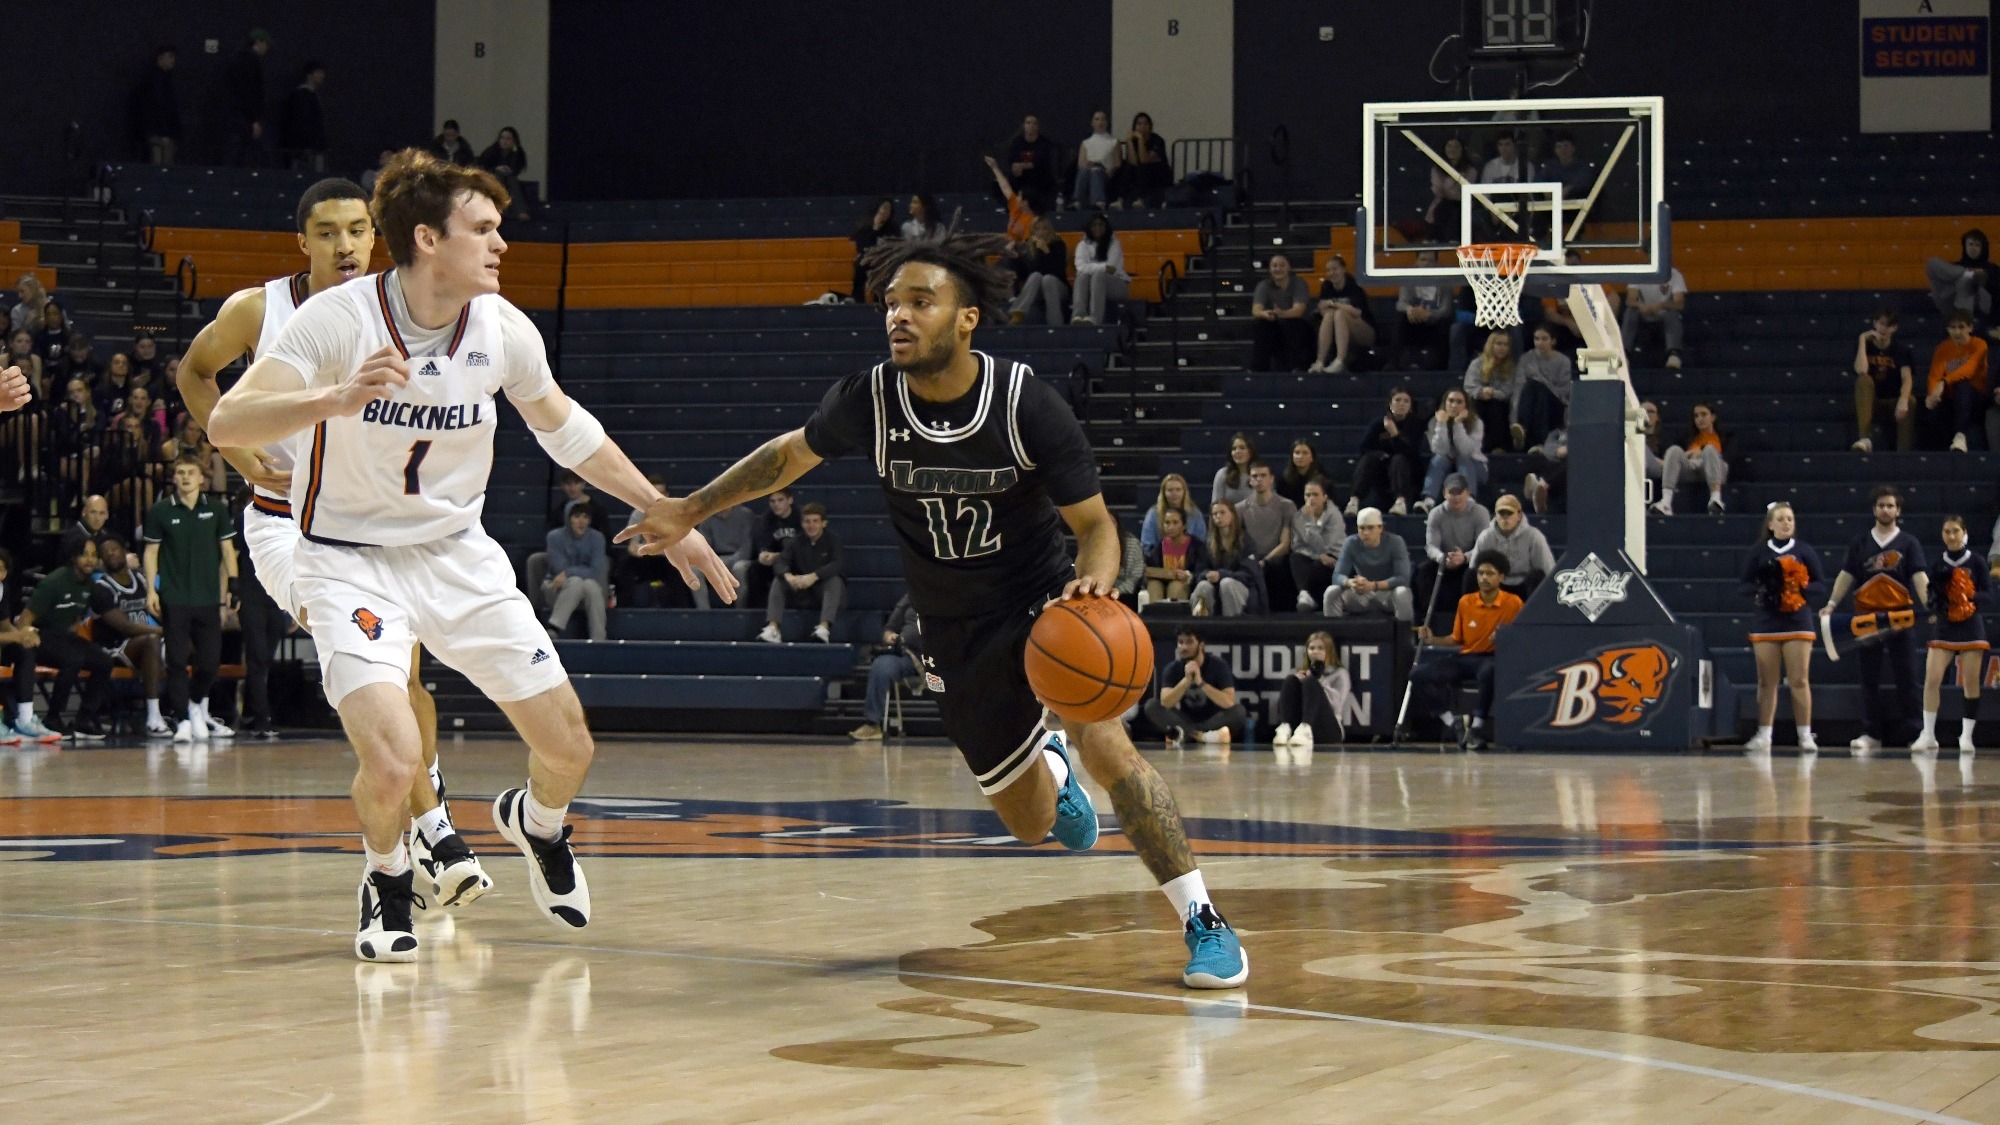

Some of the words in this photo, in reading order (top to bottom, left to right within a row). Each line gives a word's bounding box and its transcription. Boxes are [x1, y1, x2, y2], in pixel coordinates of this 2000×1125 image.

[1167, 19, 1179, 36] B
[1871, 25, 1979, 42] STUDENT
[474, 42, 485, 58] B
[1875, 48, 1976, 68] SECTION
[363, 399, 482, 430] BUCKNELL
[404, 440, 433, 495] 1
[917, 498, 1003, 560] 12
[1554, 569, 1632, 599] Fairfield
[531, 654, 550, 665] adidas
